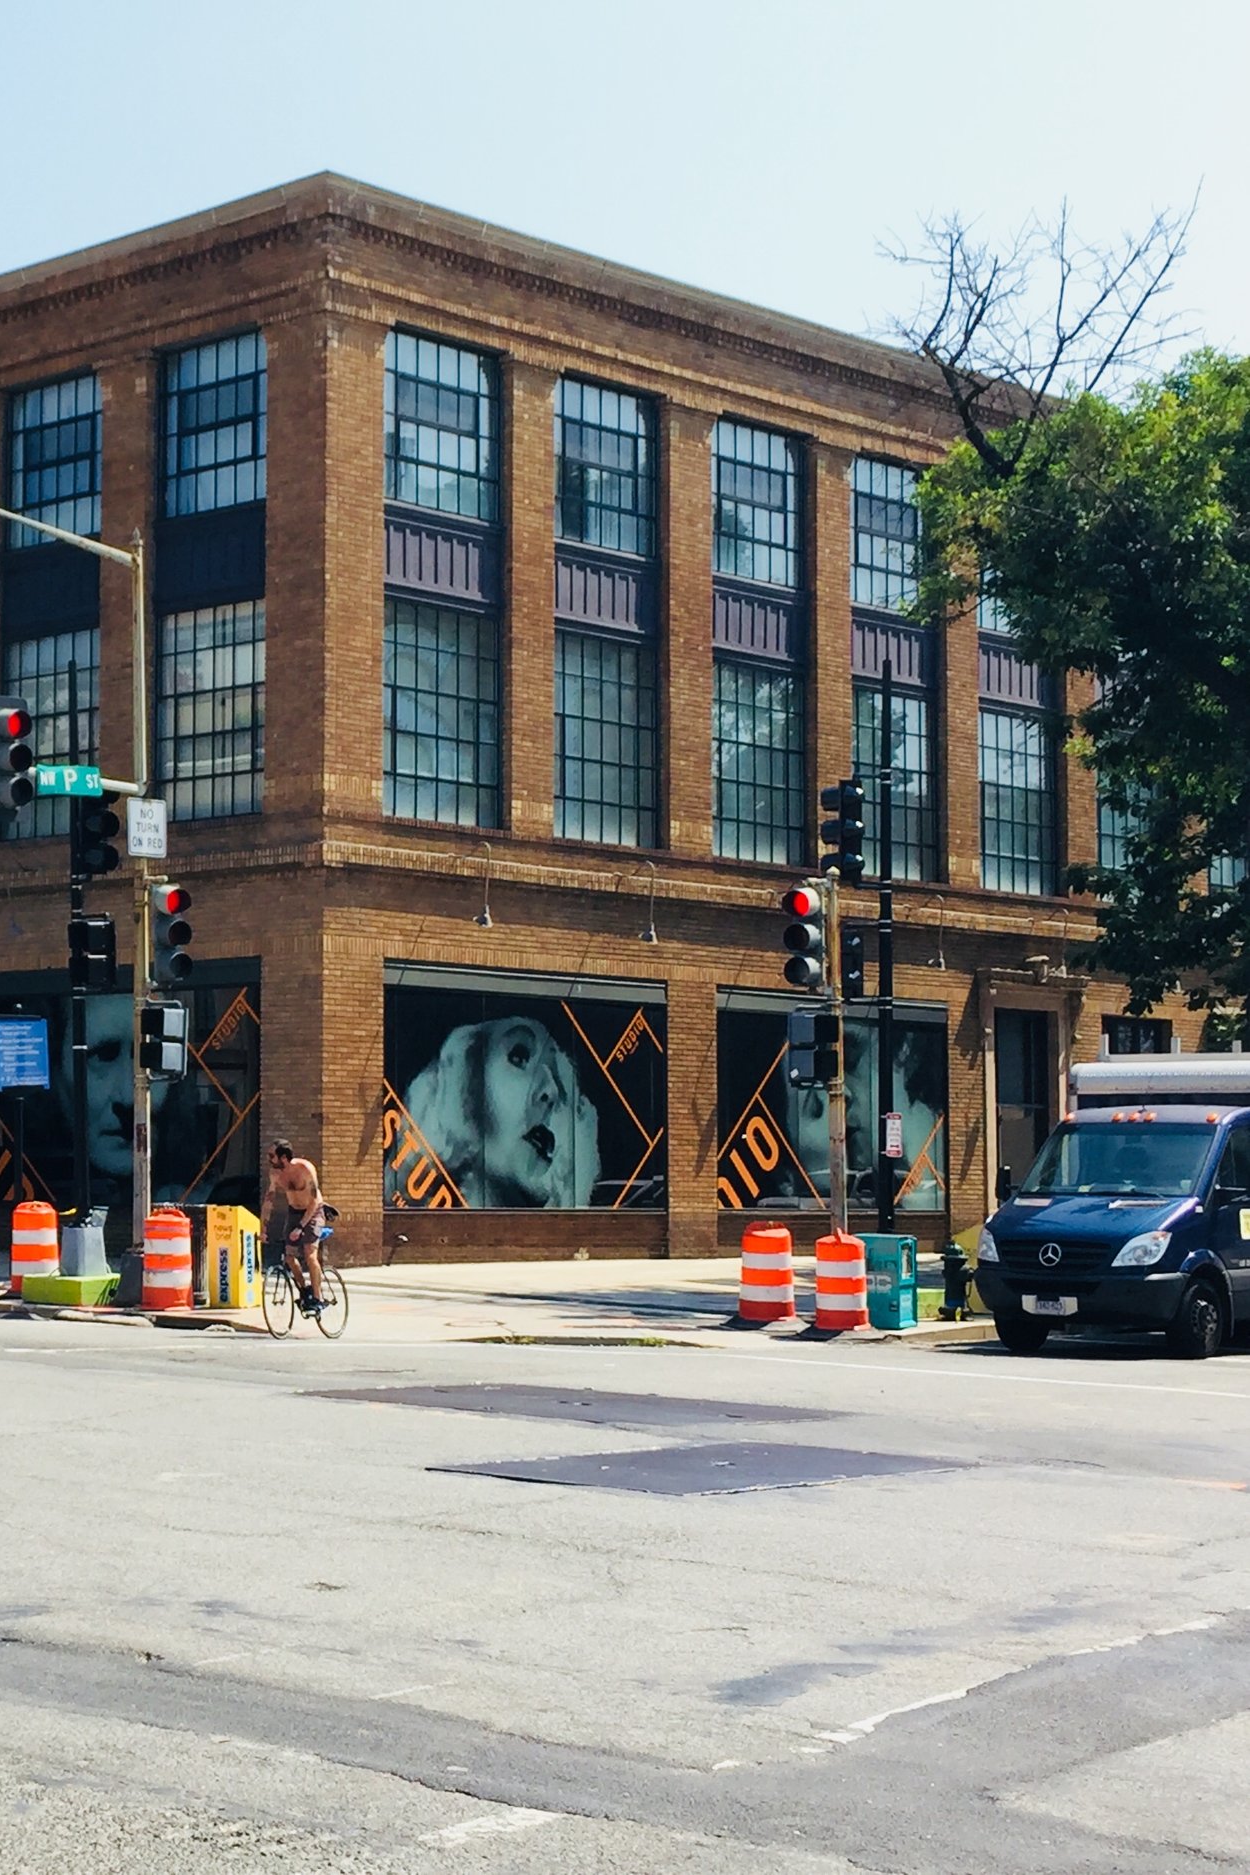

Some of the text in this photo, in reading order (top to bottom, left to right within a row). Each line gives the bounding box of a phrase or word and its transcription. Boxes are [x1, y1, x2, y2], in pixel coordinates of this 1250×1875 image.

[40, 768, 100, 792] NW P ST
[140, 808, 154, 820] NO
[136, 821, 160, 833] TURN
[132, 836, 163, 849] ON RED
[212, 1003, 246, 1050] STUDIO
[616, 1019, 644, 1063] STUDIO
[218, 1247, 229, 1303] express
